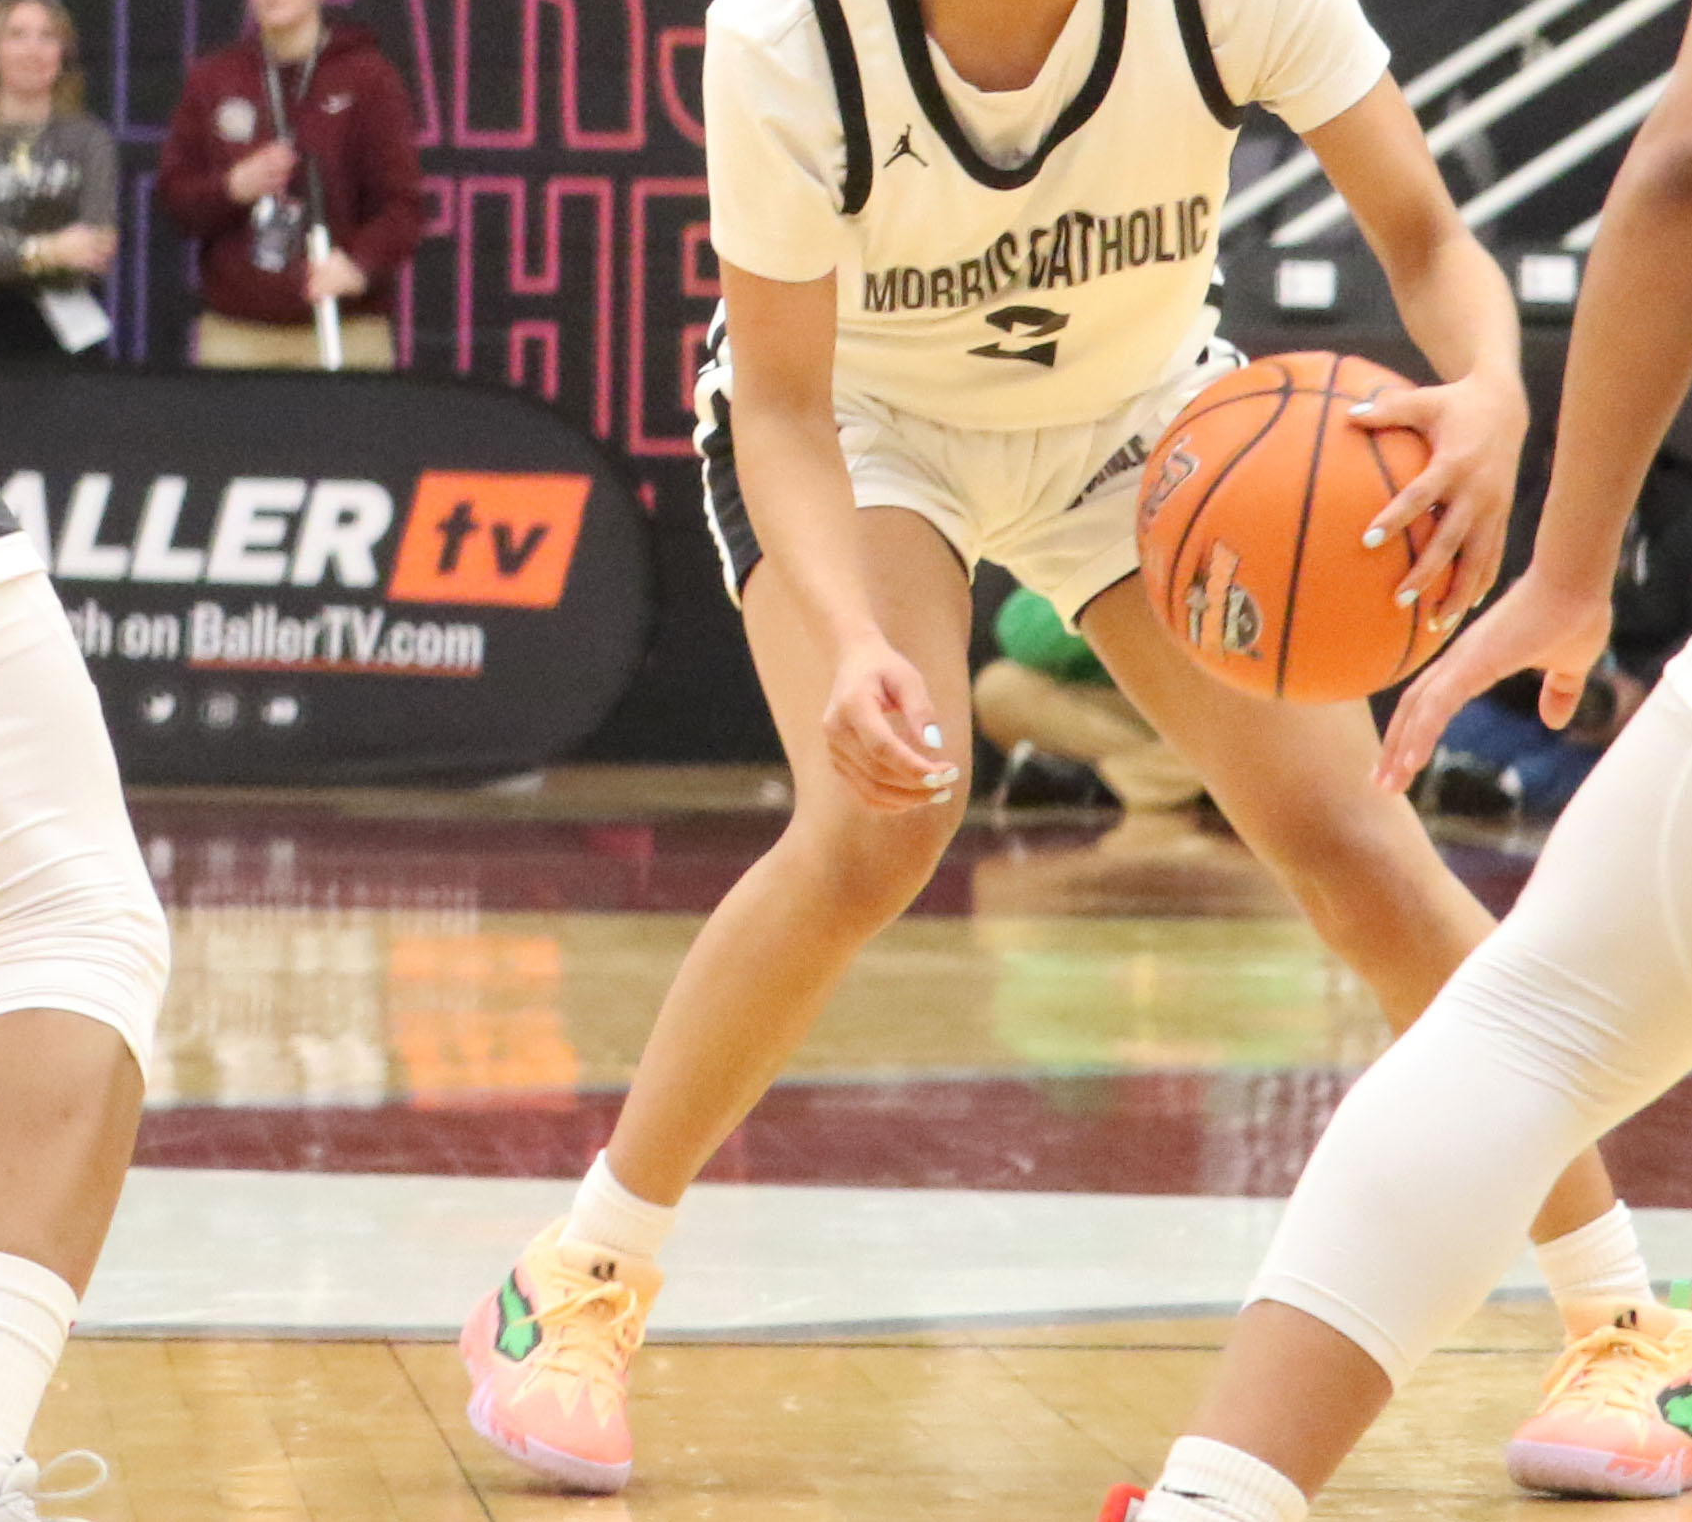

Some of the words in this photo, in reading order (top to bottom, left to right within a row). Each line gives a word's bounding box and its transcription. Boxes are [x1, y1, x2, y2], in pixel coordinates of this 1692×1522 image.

[863, 230, 1019, 313] MORRIS
[1026, 194, 1211, 291] CATHOLIC
[966, 305, 1070, 368] 2
[435, 498, 551, 576] tv
[120, 611, 181, 661] on
[187, 601, 485, 669] BallerTV.com
